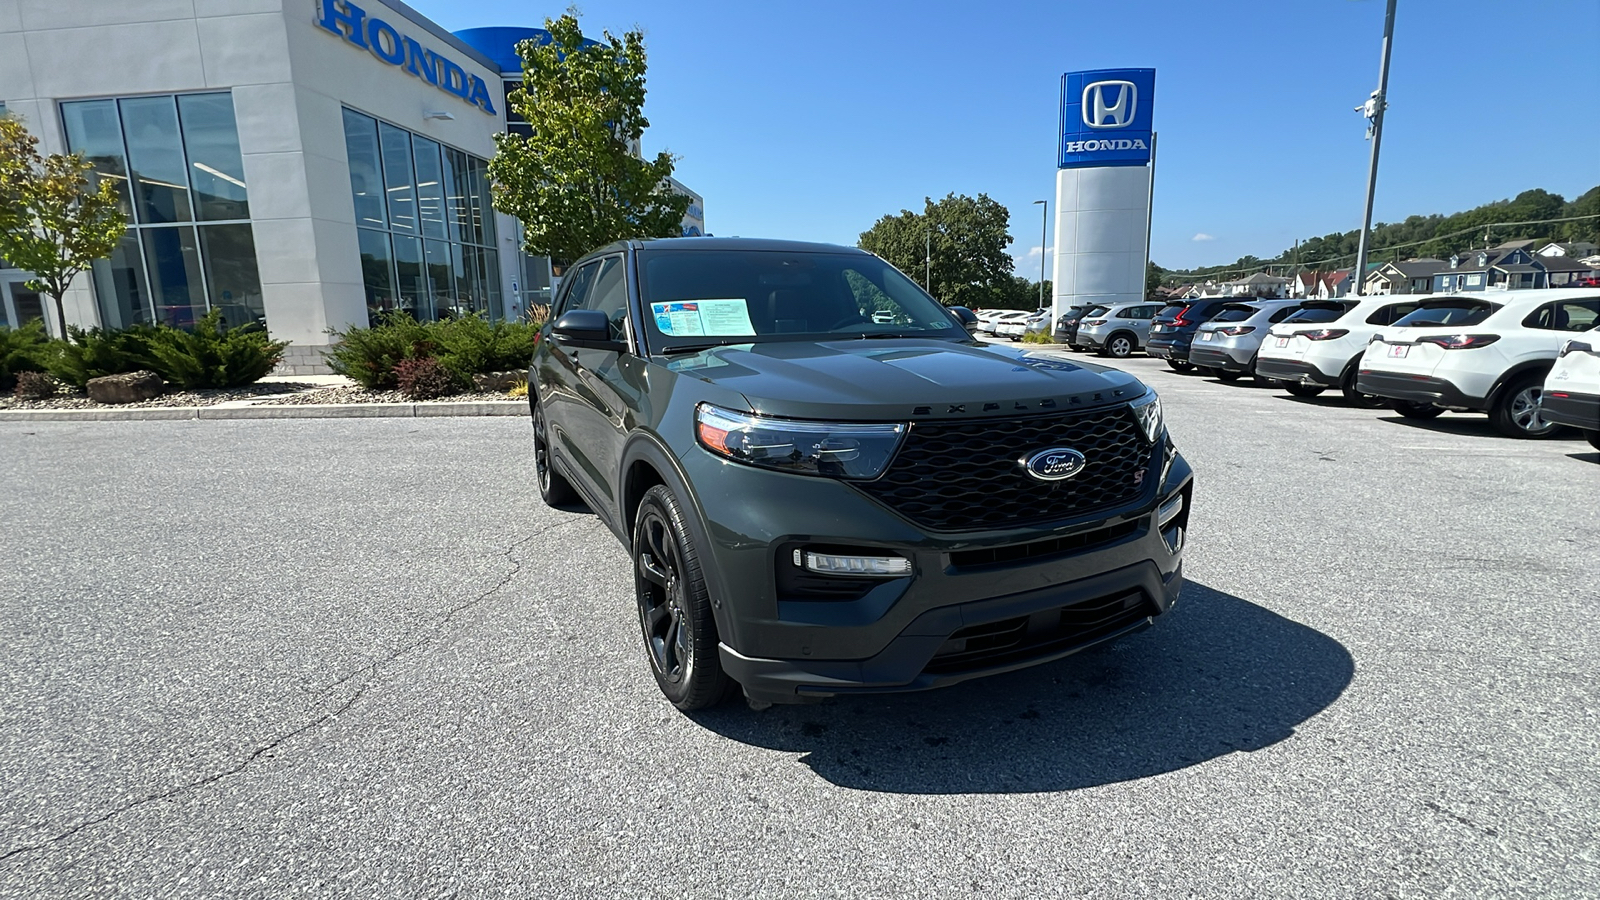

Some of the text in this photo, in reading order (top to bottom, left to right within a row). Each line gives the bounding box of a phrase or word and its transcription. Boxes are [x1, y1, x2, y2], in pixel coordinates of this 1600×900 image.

[319, 0, 497, 115] HONDA
[1066, 139, 1148, 153] HONDA
[912, 389, 1124, 415] EXPLORER
[1044, 454, 1075, 474] Ford
